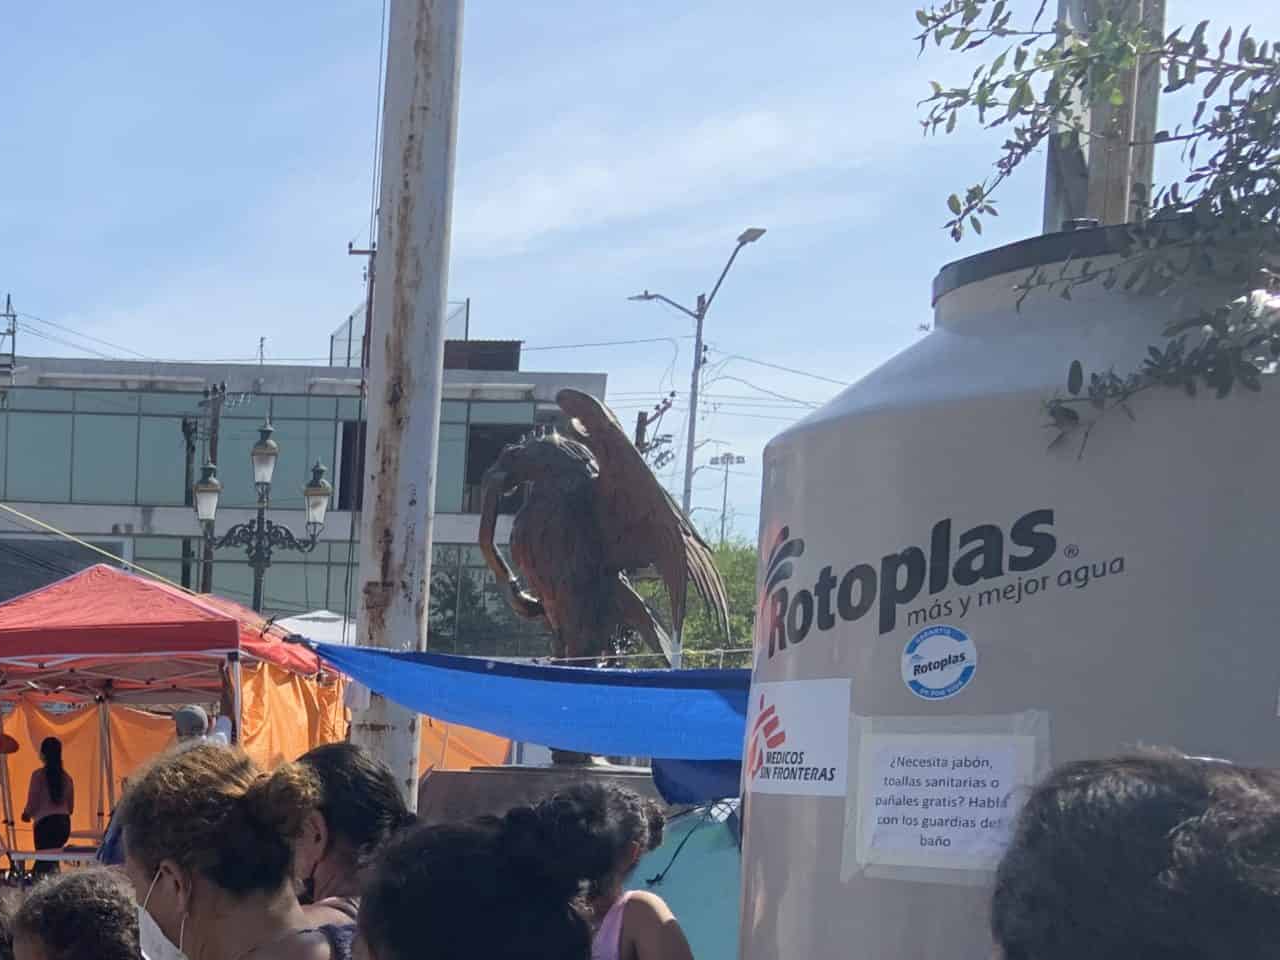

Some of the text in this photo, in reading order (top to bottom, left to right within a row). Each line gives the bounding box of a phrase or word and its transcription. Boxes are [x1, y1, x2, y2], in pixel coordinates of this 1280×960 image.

[767, 508, 1057, 659] Rotoplas
[907, 556, 1125, 627] más y mejor agua
[913, 652, 966, 677] Rotoplas
[890, 756, 993, 770] ¿Necesita jabón,
[773, 767, 836, 782] FRONTERAS
[884, 776, 1000, 788] toallas sanitarias o
[875, 796, 919, 808] pañales
[922, 796, 965, 809] gratis?
[877, 816, 898, 825] con
[902, 815, 919, 826] los
[921, 816, 976, 829] guardias
[920, 834, 951, 847] baño
